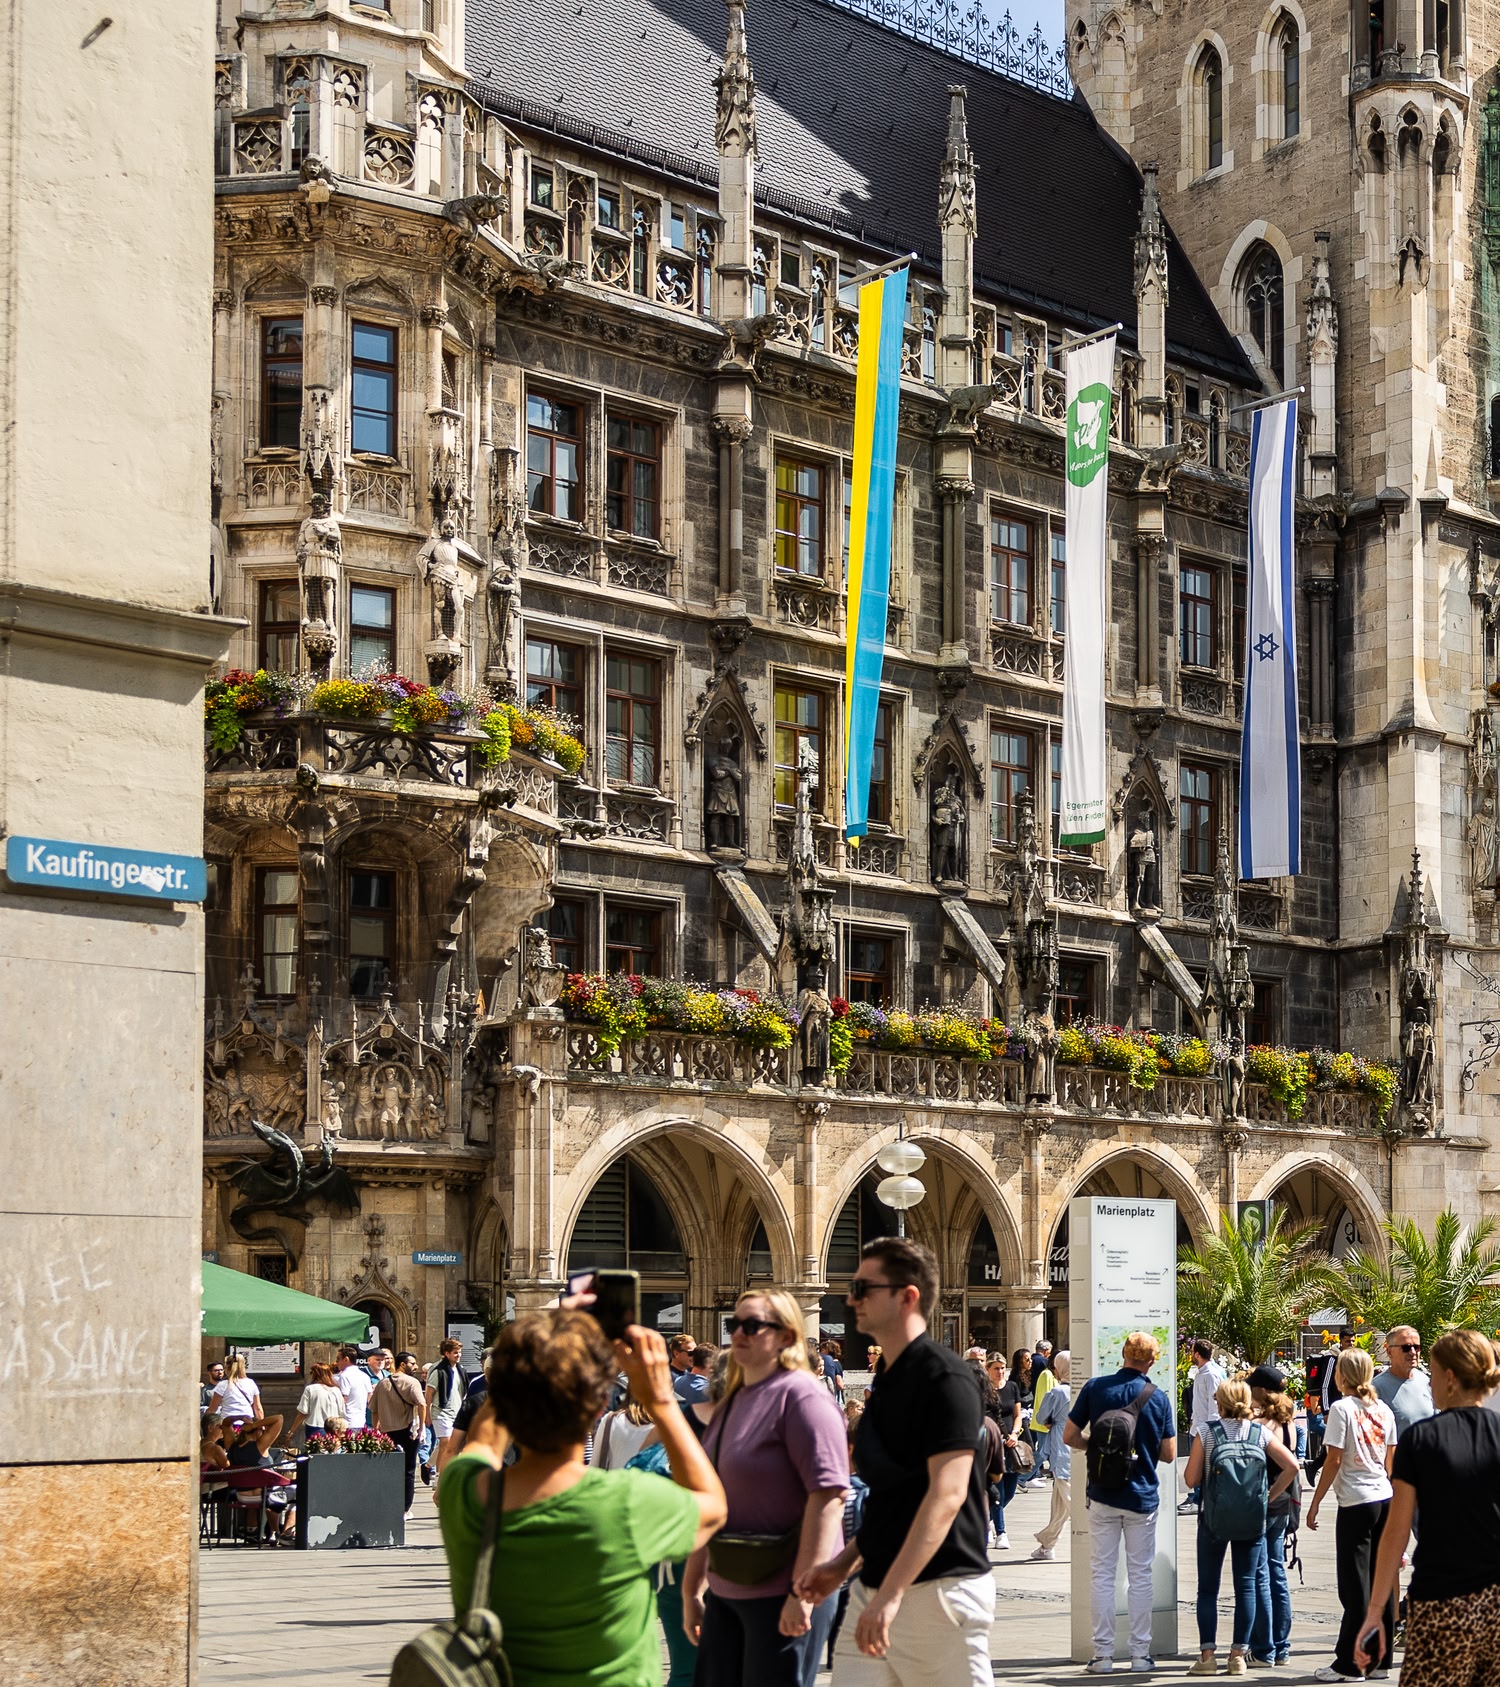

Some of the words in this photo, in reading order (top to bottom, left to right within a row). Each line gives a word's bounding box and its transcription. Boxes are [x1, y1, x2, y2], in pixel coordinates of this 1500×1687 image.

[1097, 1205, 1155, 1217] Marienplatz
[418, 1253, 457, 1263] Marienplatz
[3, 1320, 189, 1386] ASSANGE
